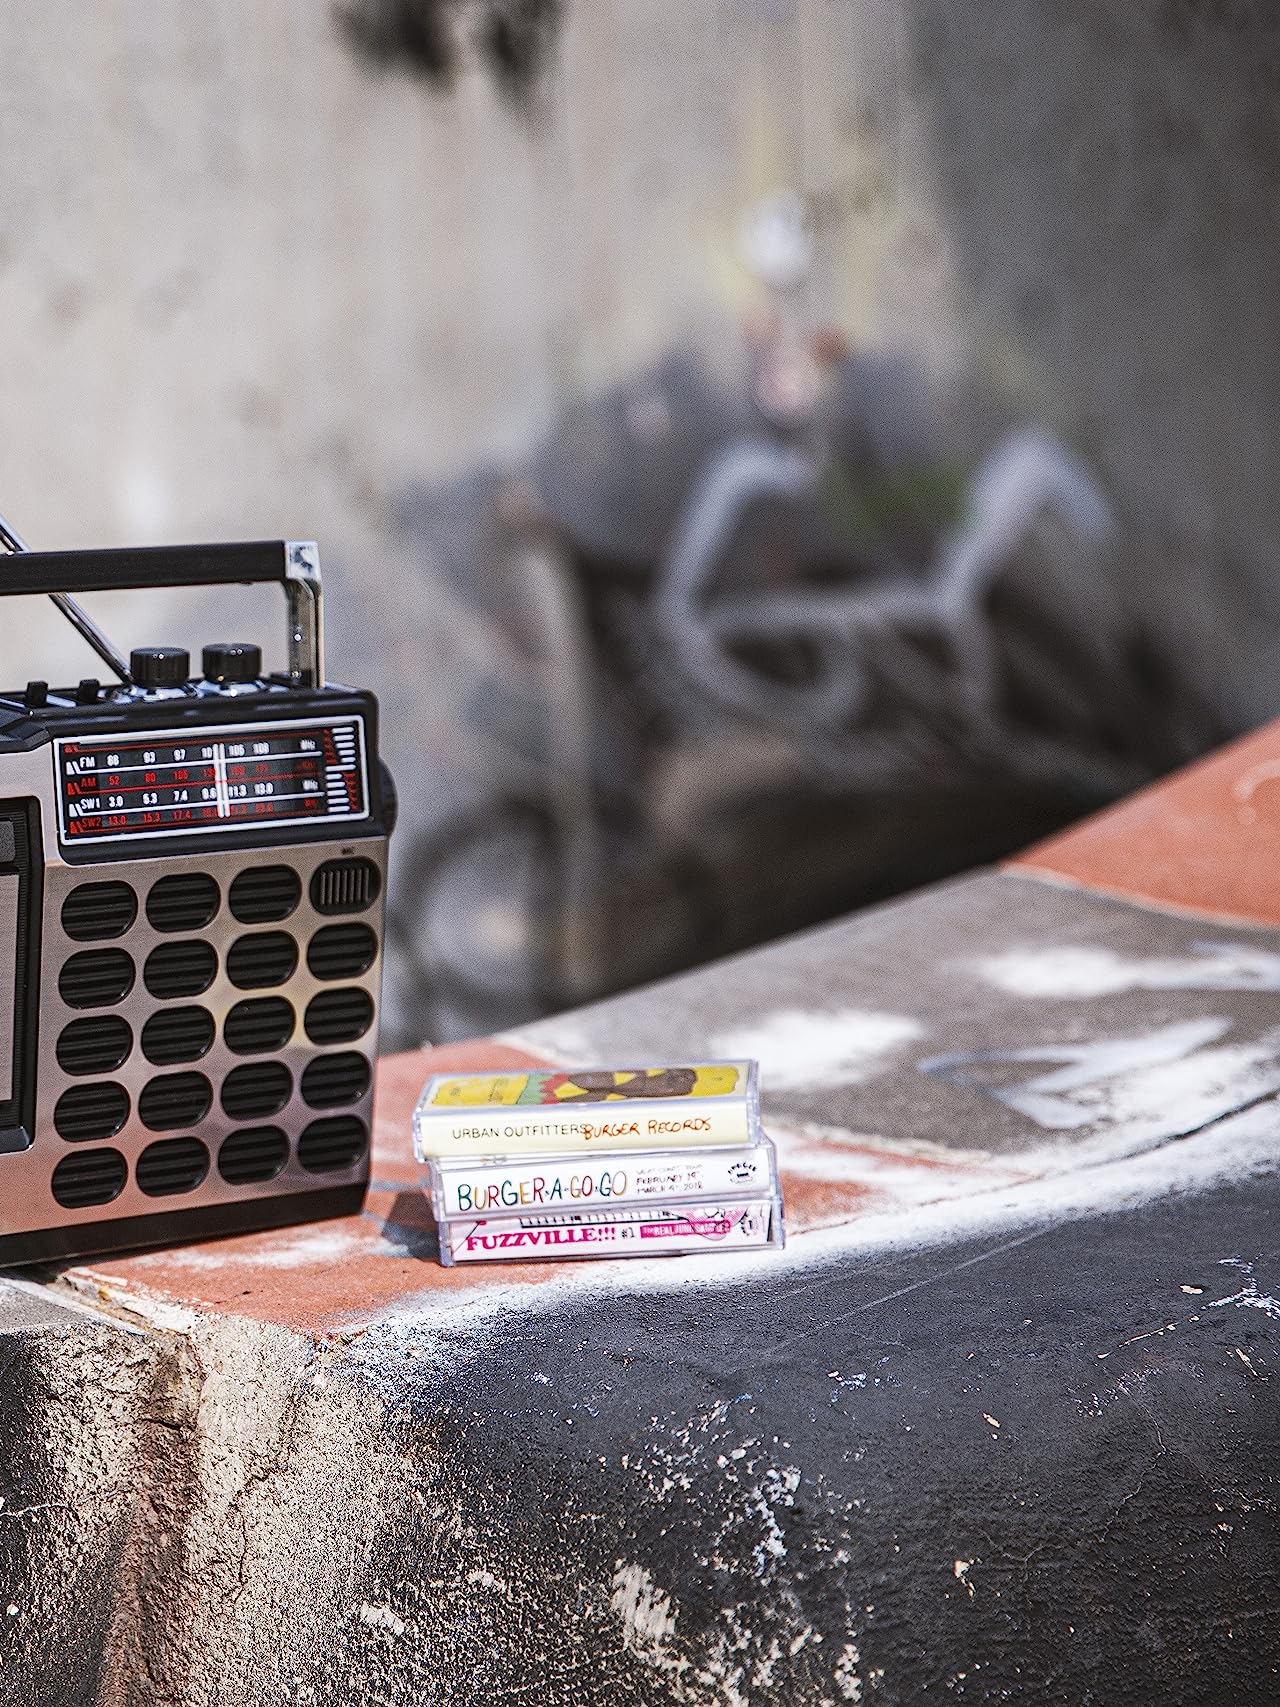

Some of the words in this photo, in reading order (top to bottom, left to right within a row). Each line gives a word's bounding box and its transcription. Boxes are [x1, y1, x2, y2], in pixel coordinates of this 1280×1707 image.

[80, 757, 95, 768] FM
[107, 754, 120, 767] 88
[143, 751, 156, 764] 93
[174, 748, 187, 761] 97
[253, 742, 270, 755] 108
[81, 777, 96, 787] AM
[80, 798, 100, 810] SW1
[254, 782, 274, 795] 13.0
[82, 817, 101, 827] SW2
[452, 1127, 500, 1140] URBAN
[504, 1123, 586, 1138] OUTFITTERS
[584, 1119, 641, 1141] BURGER
[648, 1117, 712, 1135] RECORDS
[467, 1227, 616, 1251] FUZZVILLE!!!
[621, 1227, 636, 1239] #1
